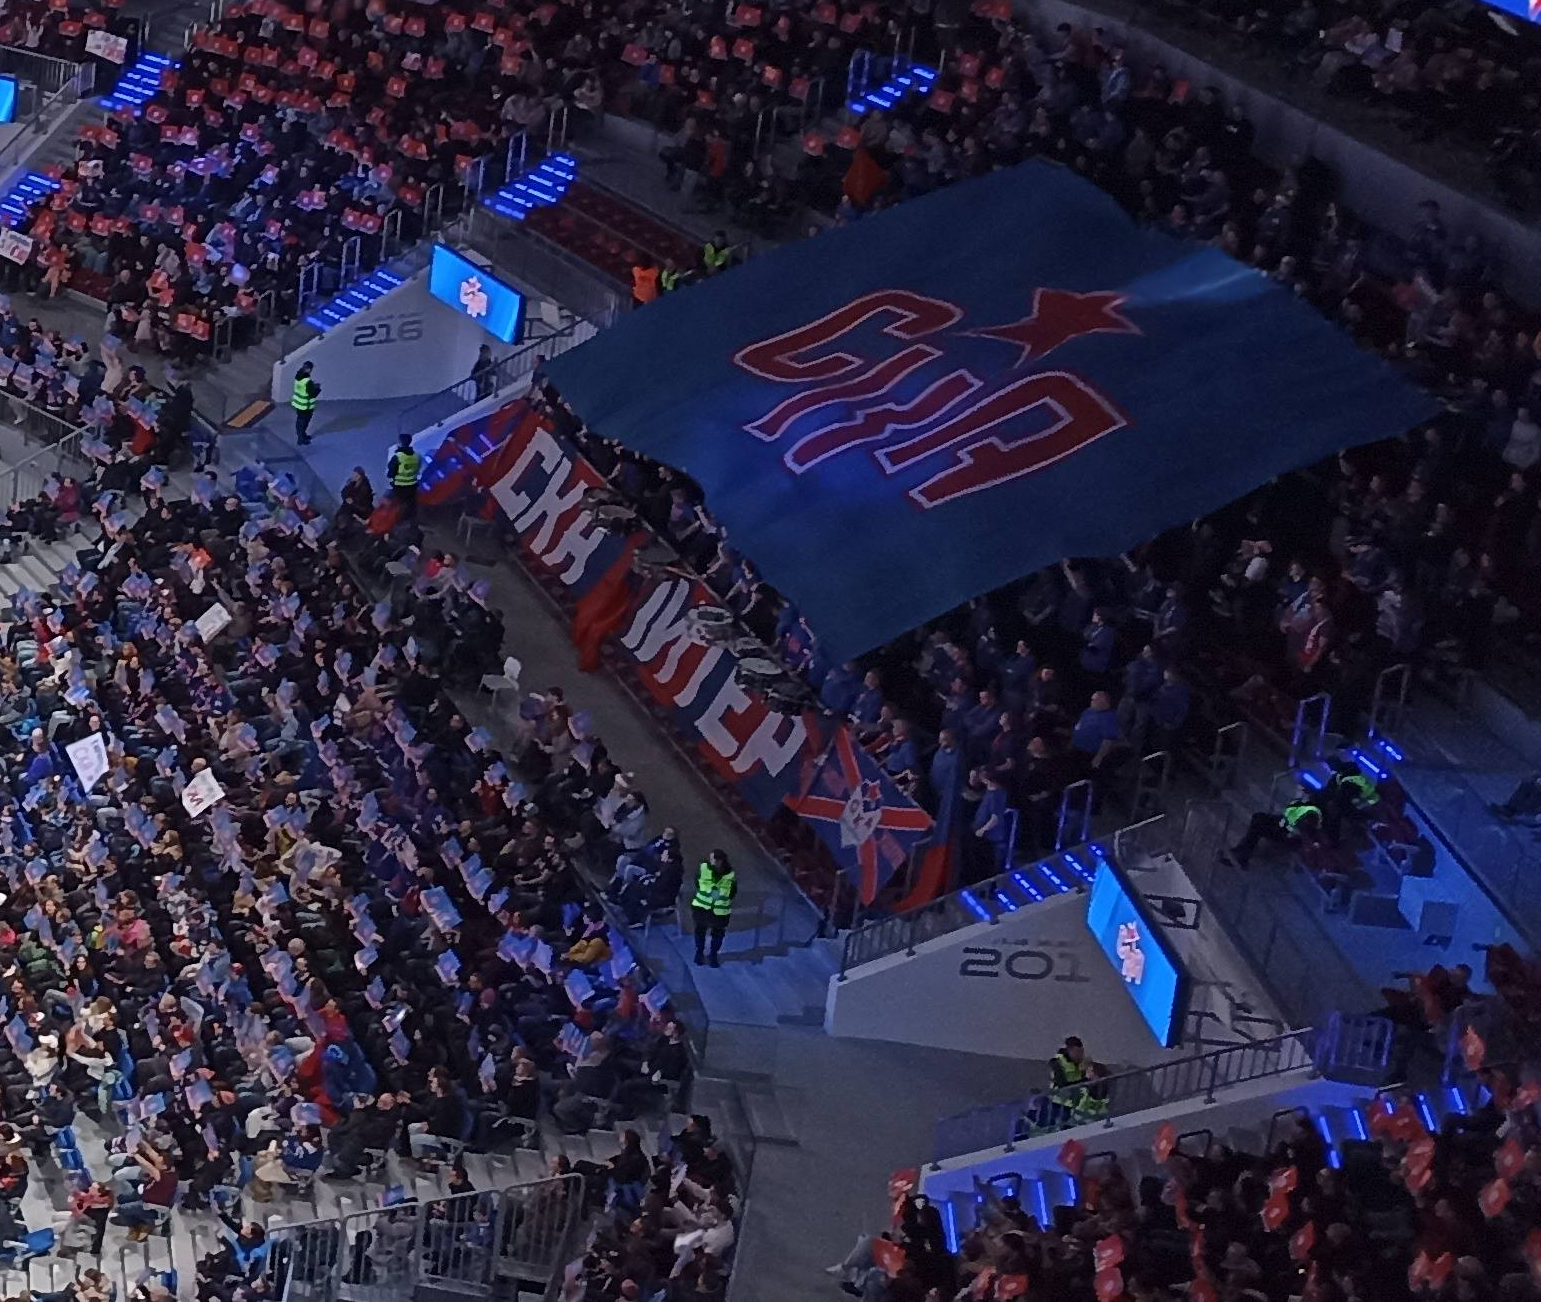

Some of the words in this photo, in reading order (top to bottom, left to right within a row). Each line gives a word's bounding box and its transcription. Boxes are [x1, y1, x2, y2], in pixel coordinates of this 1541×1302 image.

[353, 318, 424, 347] 216
[731, 287, 1131, 510] СКА
[959, 947, 1091, 983] 201
